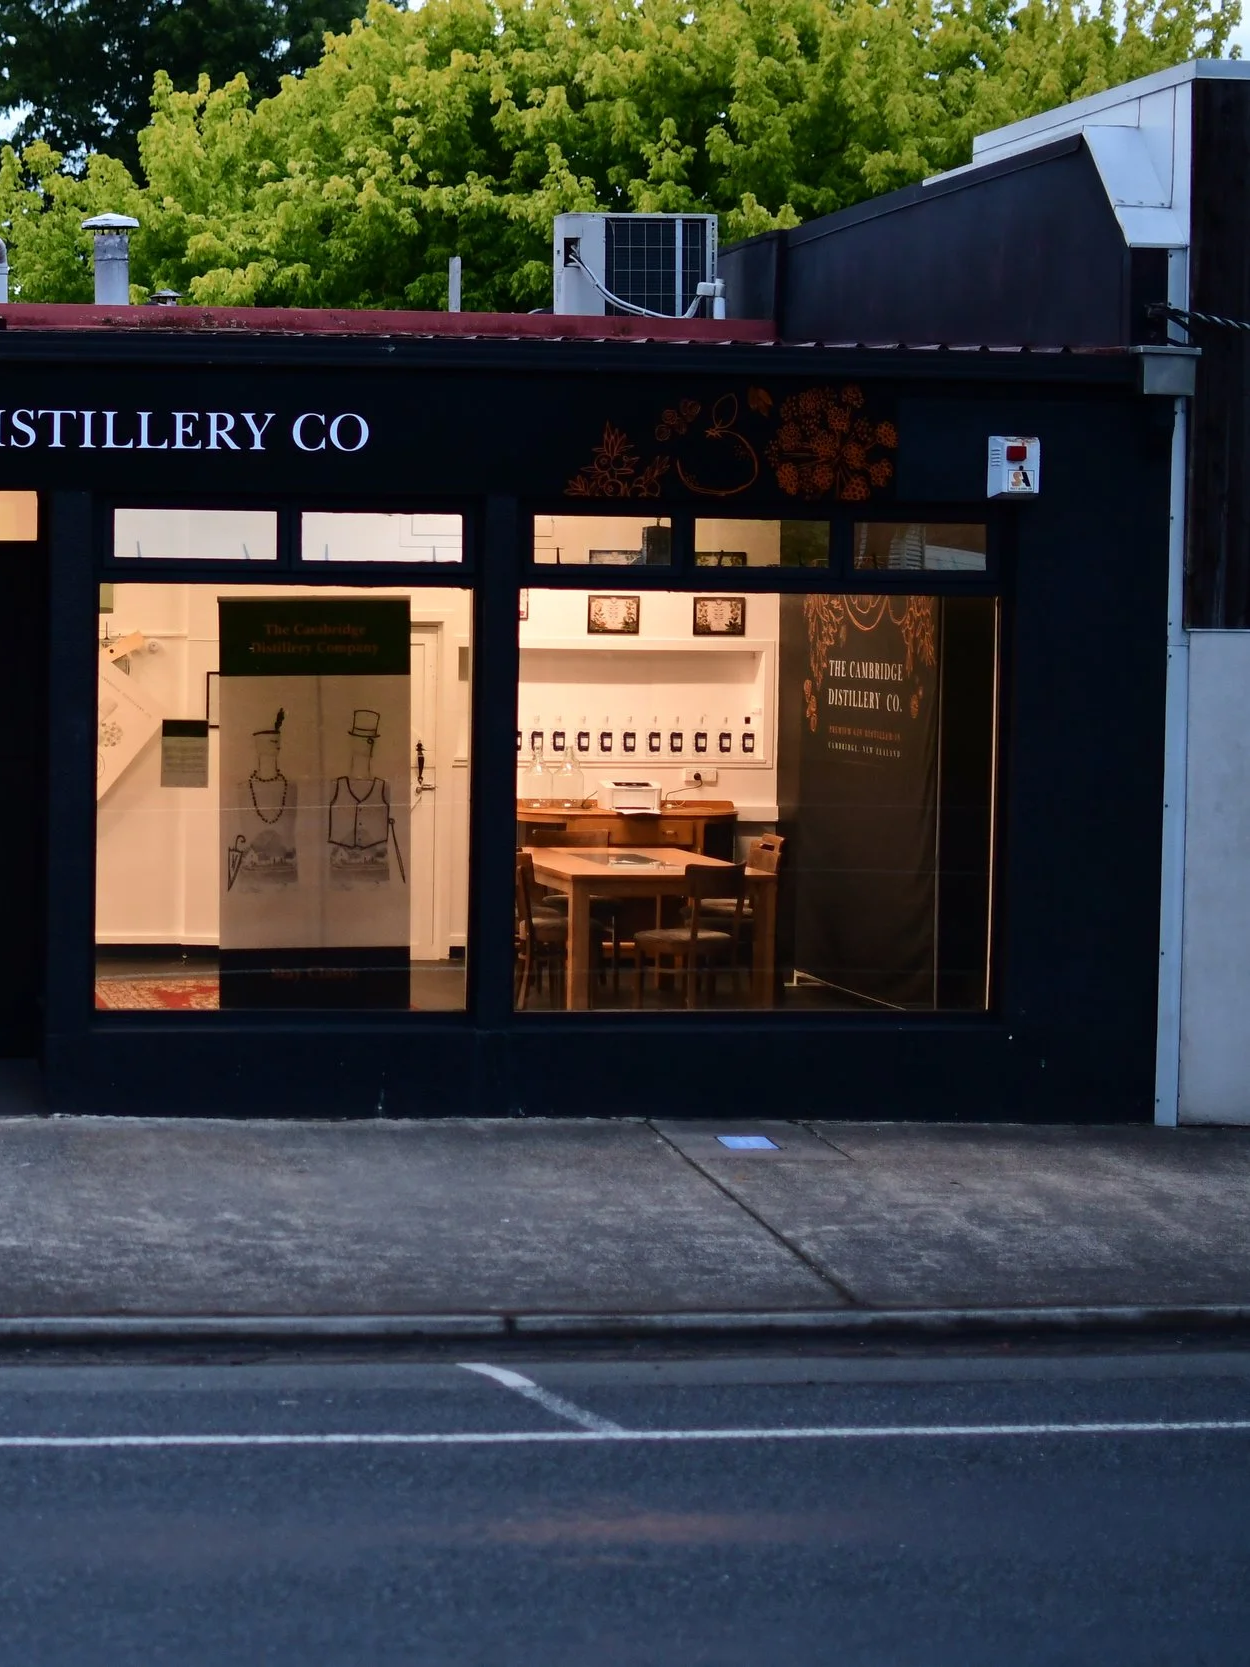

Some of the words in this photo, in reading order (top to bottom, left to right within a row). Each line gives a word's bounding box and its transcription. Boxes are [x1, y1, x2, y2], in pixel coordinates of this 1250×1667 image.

[292, 412, 370, 452] CO
[263, 623, 290, 636] The
[293, 623, 367, 638] Cambridge
[250, 641, 312, 656] Distillery
[317, 641, 379, 657] Company
[829, 660, 846, 677] THE
[850, 661, 902, 681] CAMBRIDGE
[828, 688, 881, 710] DISTILLERY
[886, 693, 903, 713] CO.
[863, 745, 873, 753] NEW
[876, 746, 900, 758] ZEALAND
